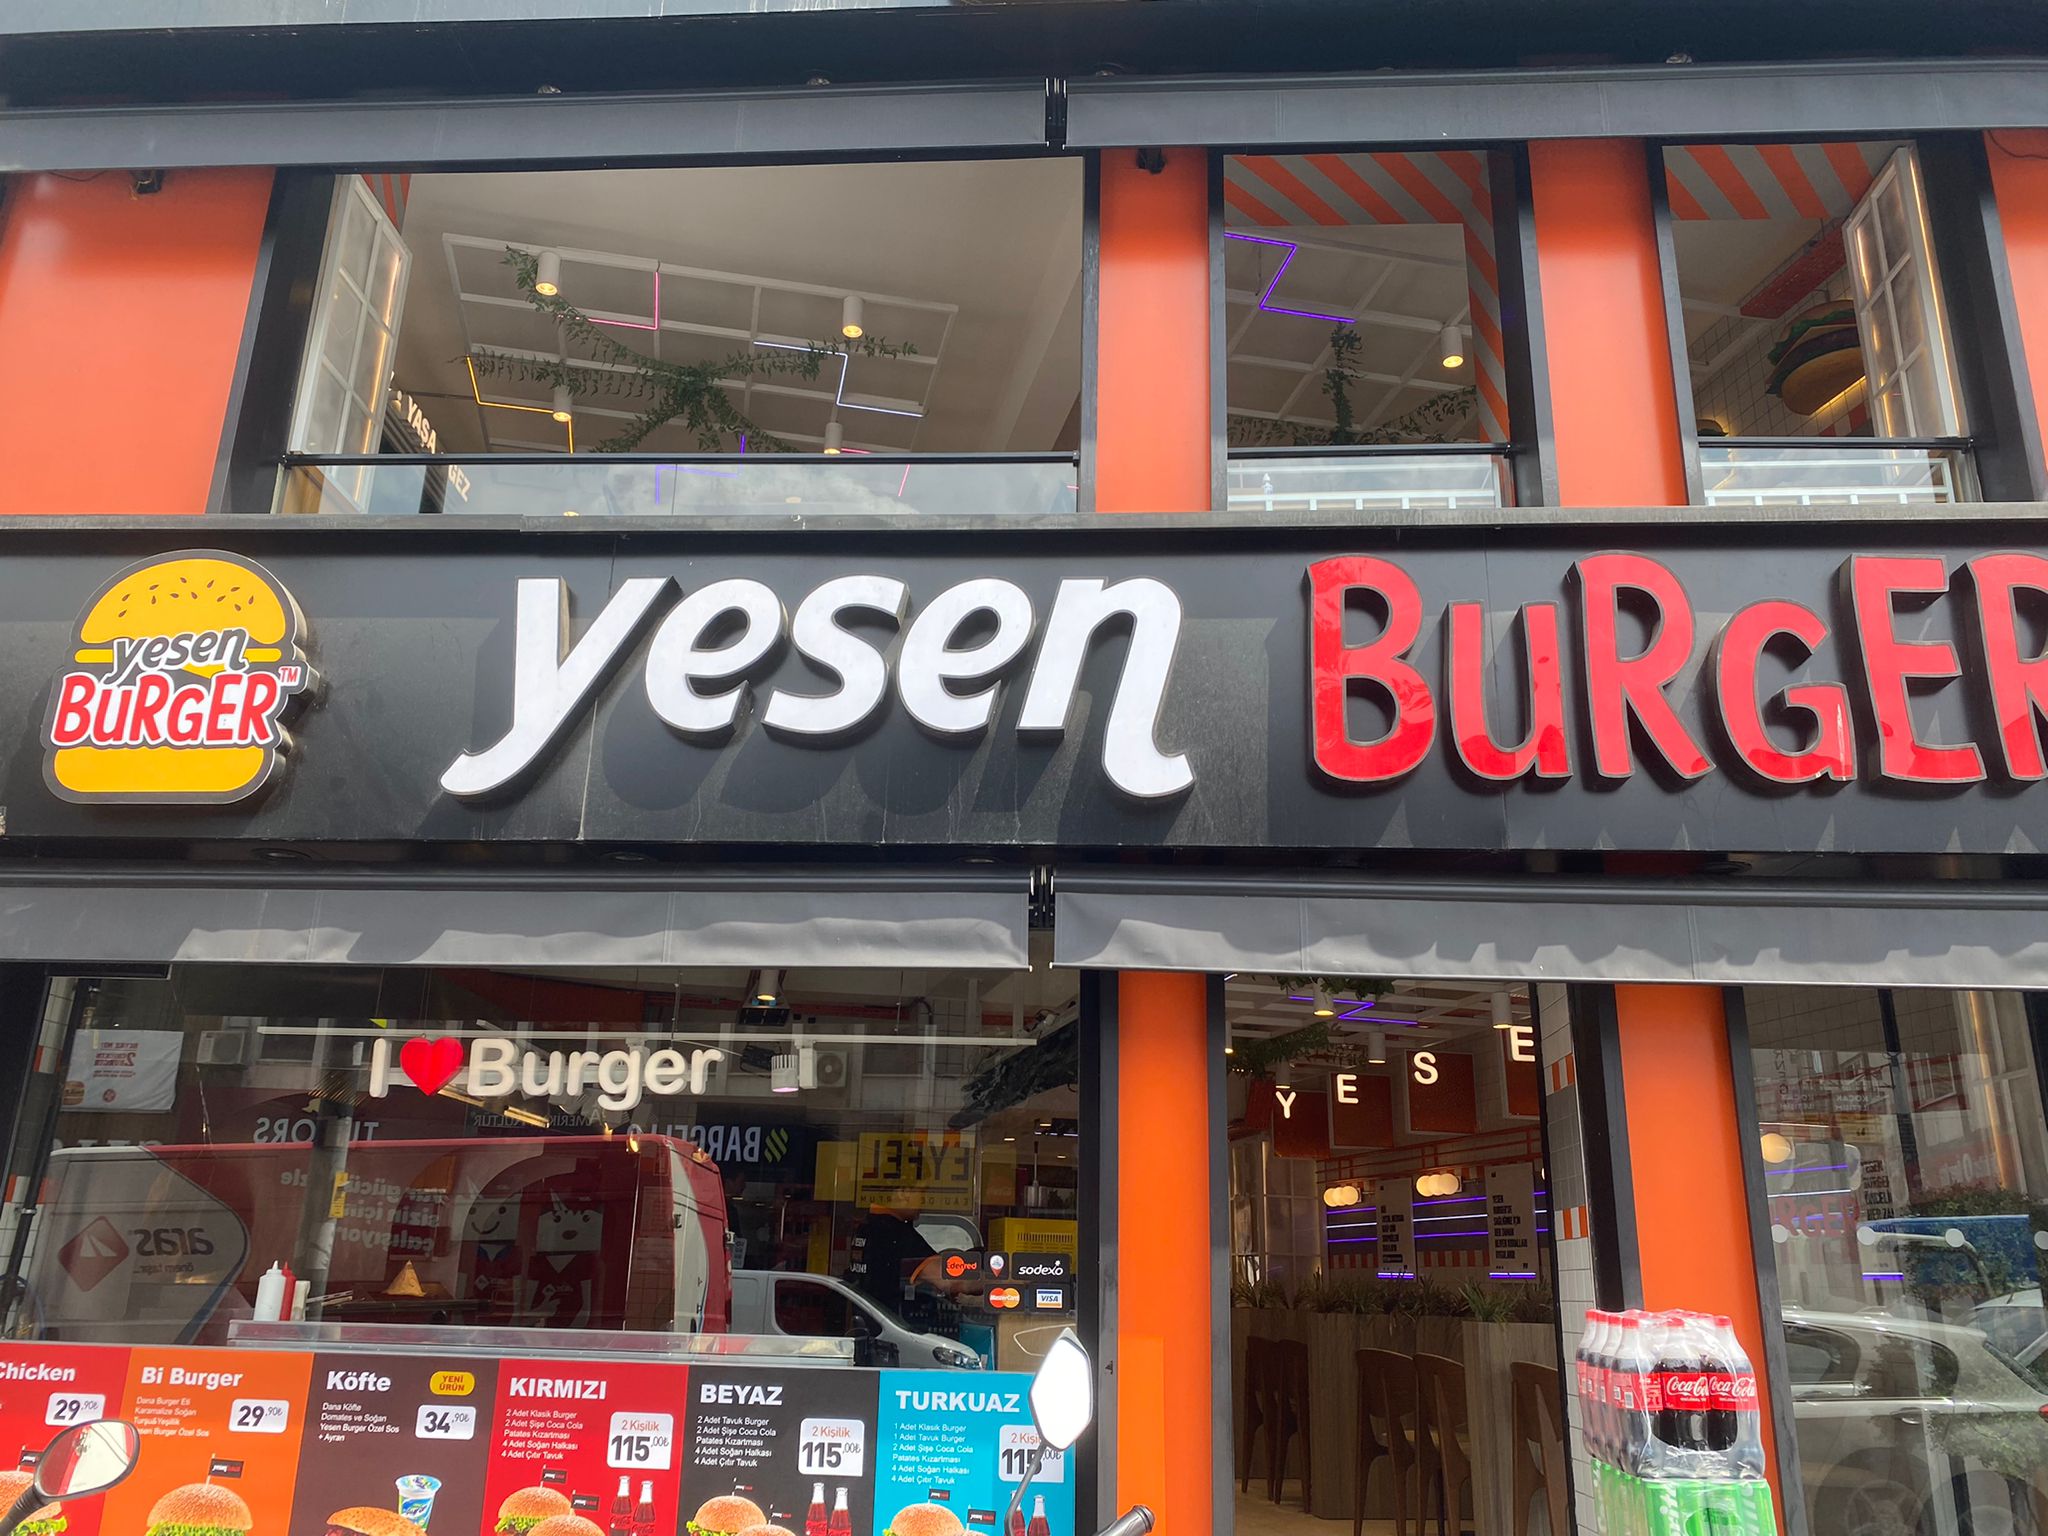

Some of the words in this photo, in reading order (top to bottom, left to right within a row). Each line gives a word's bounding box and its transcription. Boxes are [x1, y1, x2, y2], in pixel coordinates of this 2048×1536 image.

[104, 628, 249, 684] yesen
[439, 575, 1195, 797] yesen
[467, 1037, 726, 1111] Burger
[1018, 1260, 1064, 1276] sodexo
[1040, 1295, 1059, 1303] VISA
[141, 1366, 164, 1384] Bi
[169, 1367, 243, 1391] Burger
[326, 1370, 392, 1392] Köfte
[509, 1377, 607, 1400] KIRMIZI
[700, 1383, 783, 1406] BEYAZ
[322, 1402, 342, 1411] Dana
[343, 1402, 362, 1412] Köfte
[895, 1390, 1020, 1413] TURKUAZ
[320, 1412, 352, 1422] Domates
[364, 1413, 387, 1424] Soğan
[512, 1409, 529, 1417] Adet
[530, 1410, 551, 1418] Klasik
[553, 1411, 577, 1420] Burger
[511, 1419, 527, 1427] Adet
[545, 1421, 565, 1429] Coca
[566, 1422, 583, 1430] Cola
[621, 1420, 628, 1430] 2
[629, 1420, 660, 1432] Kişilik
[704, 1416, 720, 1424] Adet
[722, 1417, 743, 1425] Tavuk
[745, 1417, 769, 1426] Burger
[319, 1423, 341, 1432] Yesen
[342, 1423, 366, 1434] Burger
[385, 1424, 400, 1433] Sos
[504, 1429, 531, 1438] Patates
[703, 1427, 720, 1435] Adet
[739, 1428, 758, 1436] Coca
[759, 1429, 776, 1437] Cola
[812, 1426, 819, 1436] 2
[820, 1426, 850, 1438] Kişilik
[942, 1424, 967, 1433] Burger
[323, 1433, 346, 1444] Ayran
[696, 1437, 723, 1445] Patates
[918, 1434, 939, 1442] Tavuk
[941, 1435, 966, 1444] Burger
[1011, 1433, 1018, 1443] 2
[1019, 1433, 1041, 1445] Kişi
[509, 1440, 525, 1448] Adet
[526, 1440, 550, 1450] Soğan
[899, 1444, 916, 1452] Adet
[935, 1445, 955, 1453] Coca
[508, 1450, 524, 1459] Adet
[543, 1452, 563, 1460] Tavuk
[701, 1448, 718, 1456] Adet
[720, 1448, 743, 1458] Soğan
[892, 1454, 920, 1462] Patates
[700, 1458, 718, 1466] Adet
[737, 1458, 758, 1467] Tavuk
[898, 1465, 915, 1473] Adet
[934, 1477, 955, 1485] Tavuk
